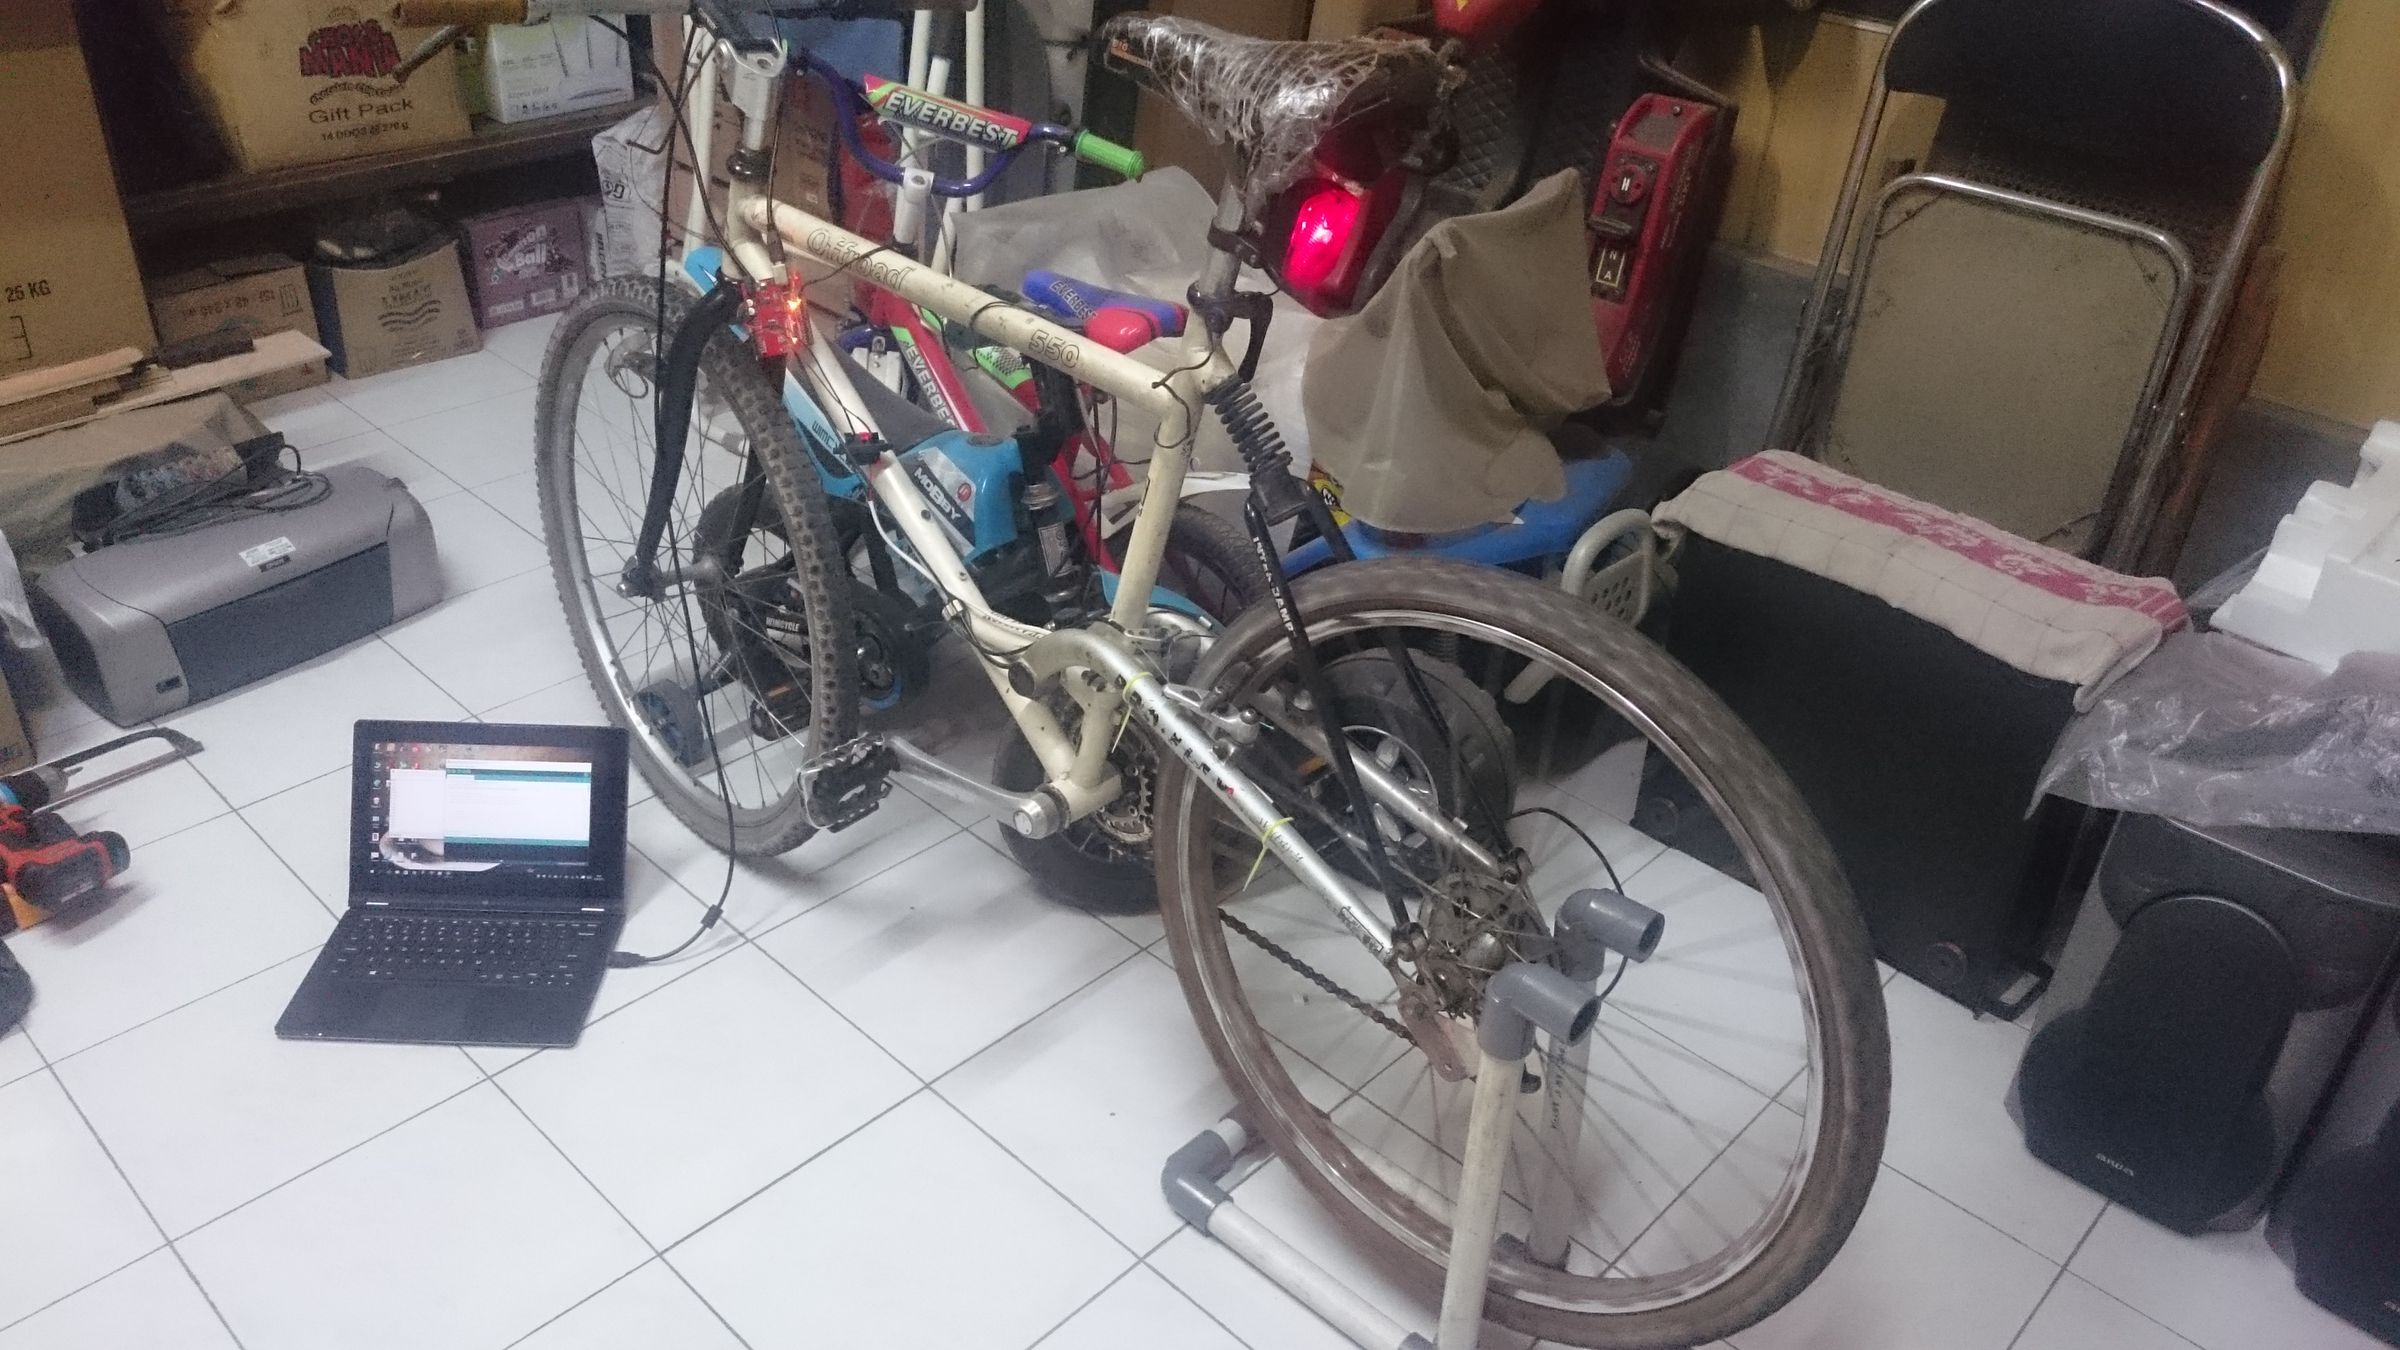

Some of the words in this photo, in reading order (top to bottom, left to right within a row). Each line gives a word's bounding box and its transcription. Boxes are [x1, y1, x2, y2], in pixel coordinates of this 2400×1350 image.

[308, 107, 350, 124] Gift
[358, 98, 414, 117] Pack
[884, 91, 1019, 146] EVERBEST
[806, 228, 917, 289] Offroad
[1603, 269, 1613, 281] A
[27, 279, 52, 300] KG
[1028, 328, 1080, 369] 550
[913, 466, 961, 521] MOBBY
